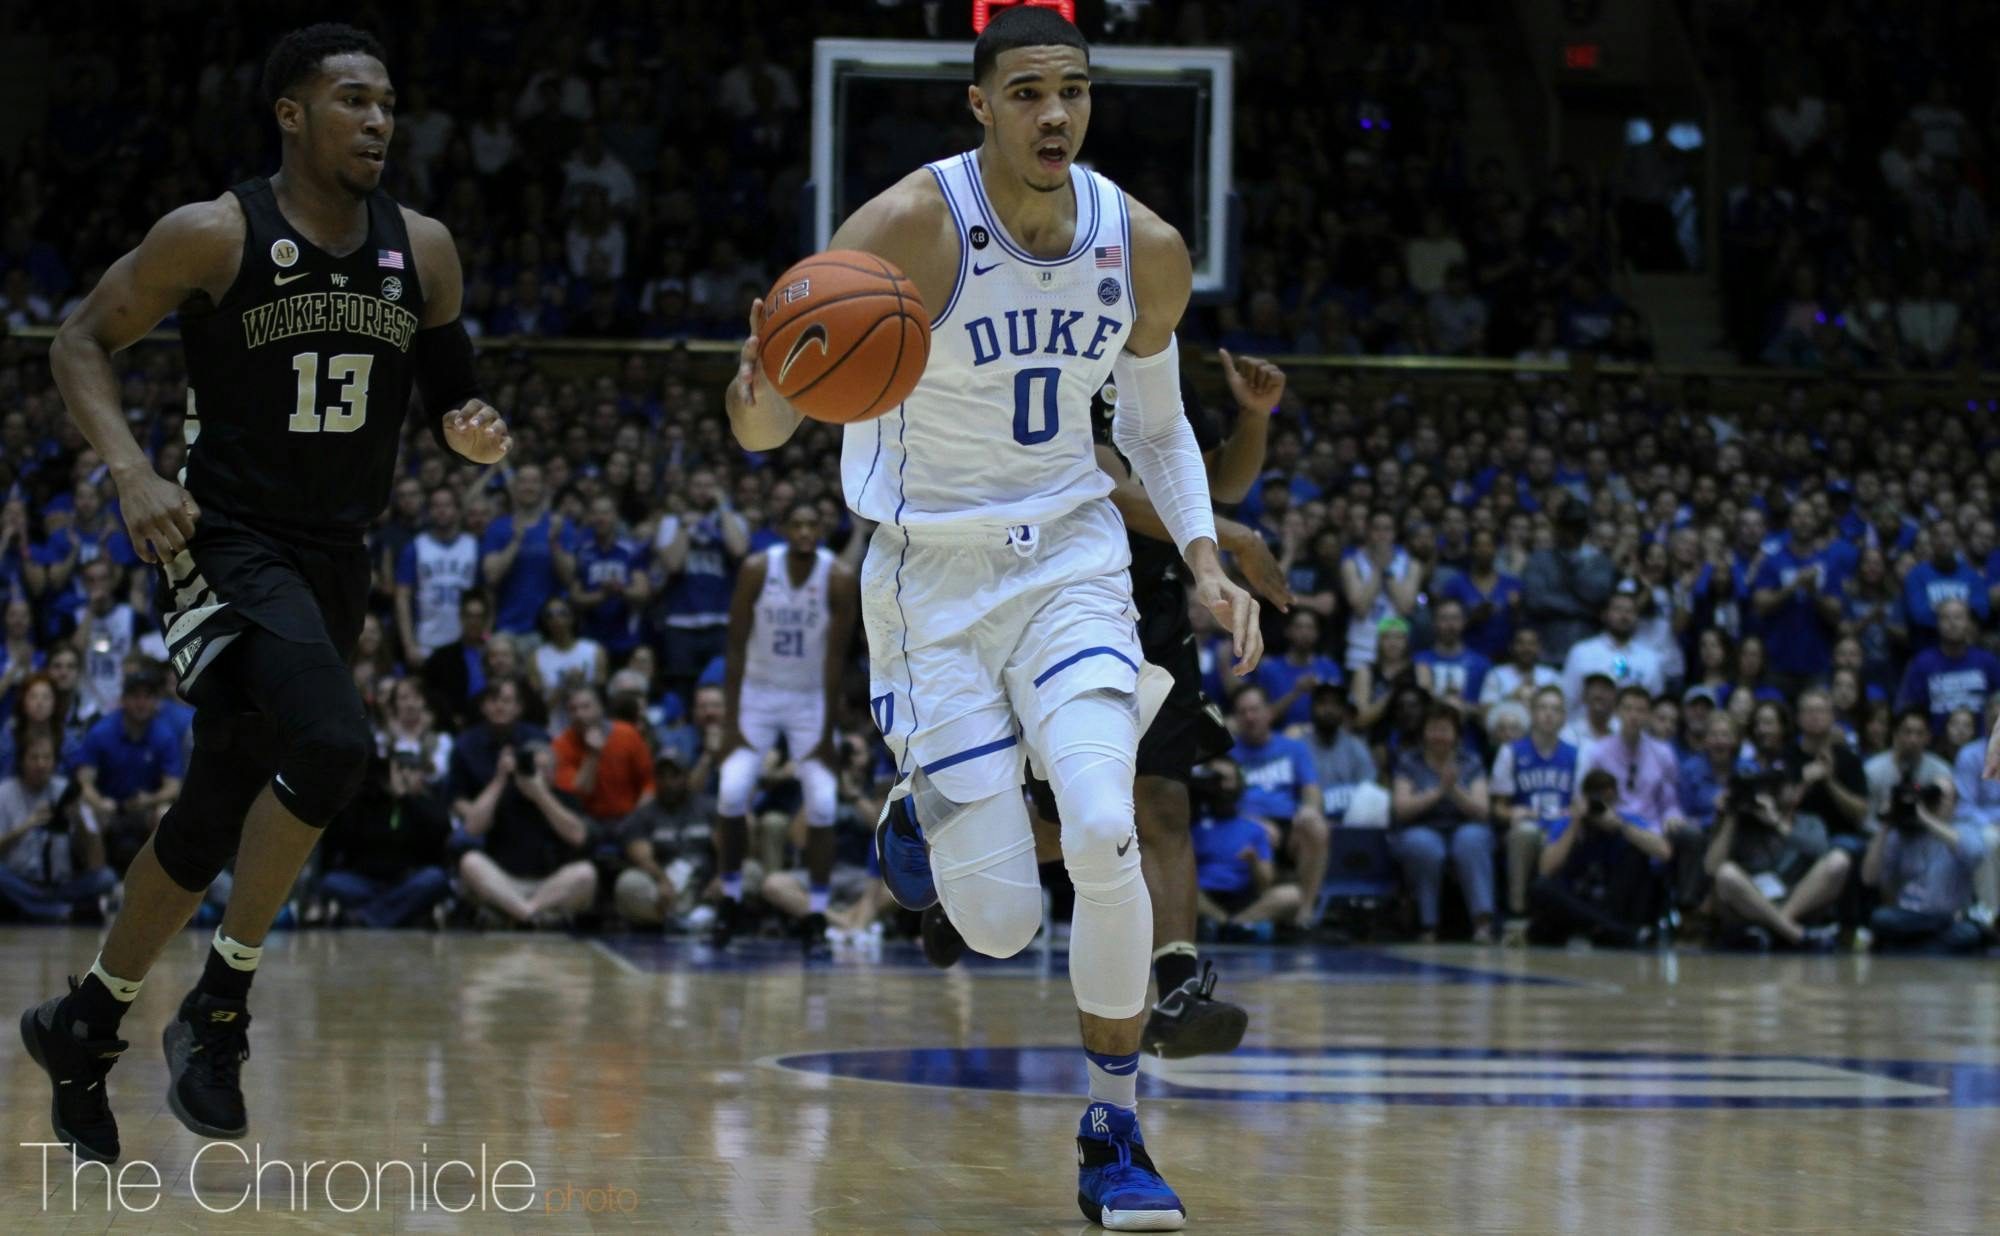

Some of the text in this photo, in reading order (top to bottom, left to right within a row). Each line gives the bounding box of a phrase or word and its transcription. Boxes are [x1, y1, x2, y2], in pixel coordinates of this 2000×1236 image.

[275, 246, 295, 260] AP
[971, 232, 985, 243] KB
[330, 273, 349, 288] WF
[242, 292, 418, 352] WAKE FOREST
[964, 308, 1123, 366] DUKE
[288, 352, 374, 432] 13
[1012, 367, 1062, 446] 0
[773, 629, 804, 658] 21
